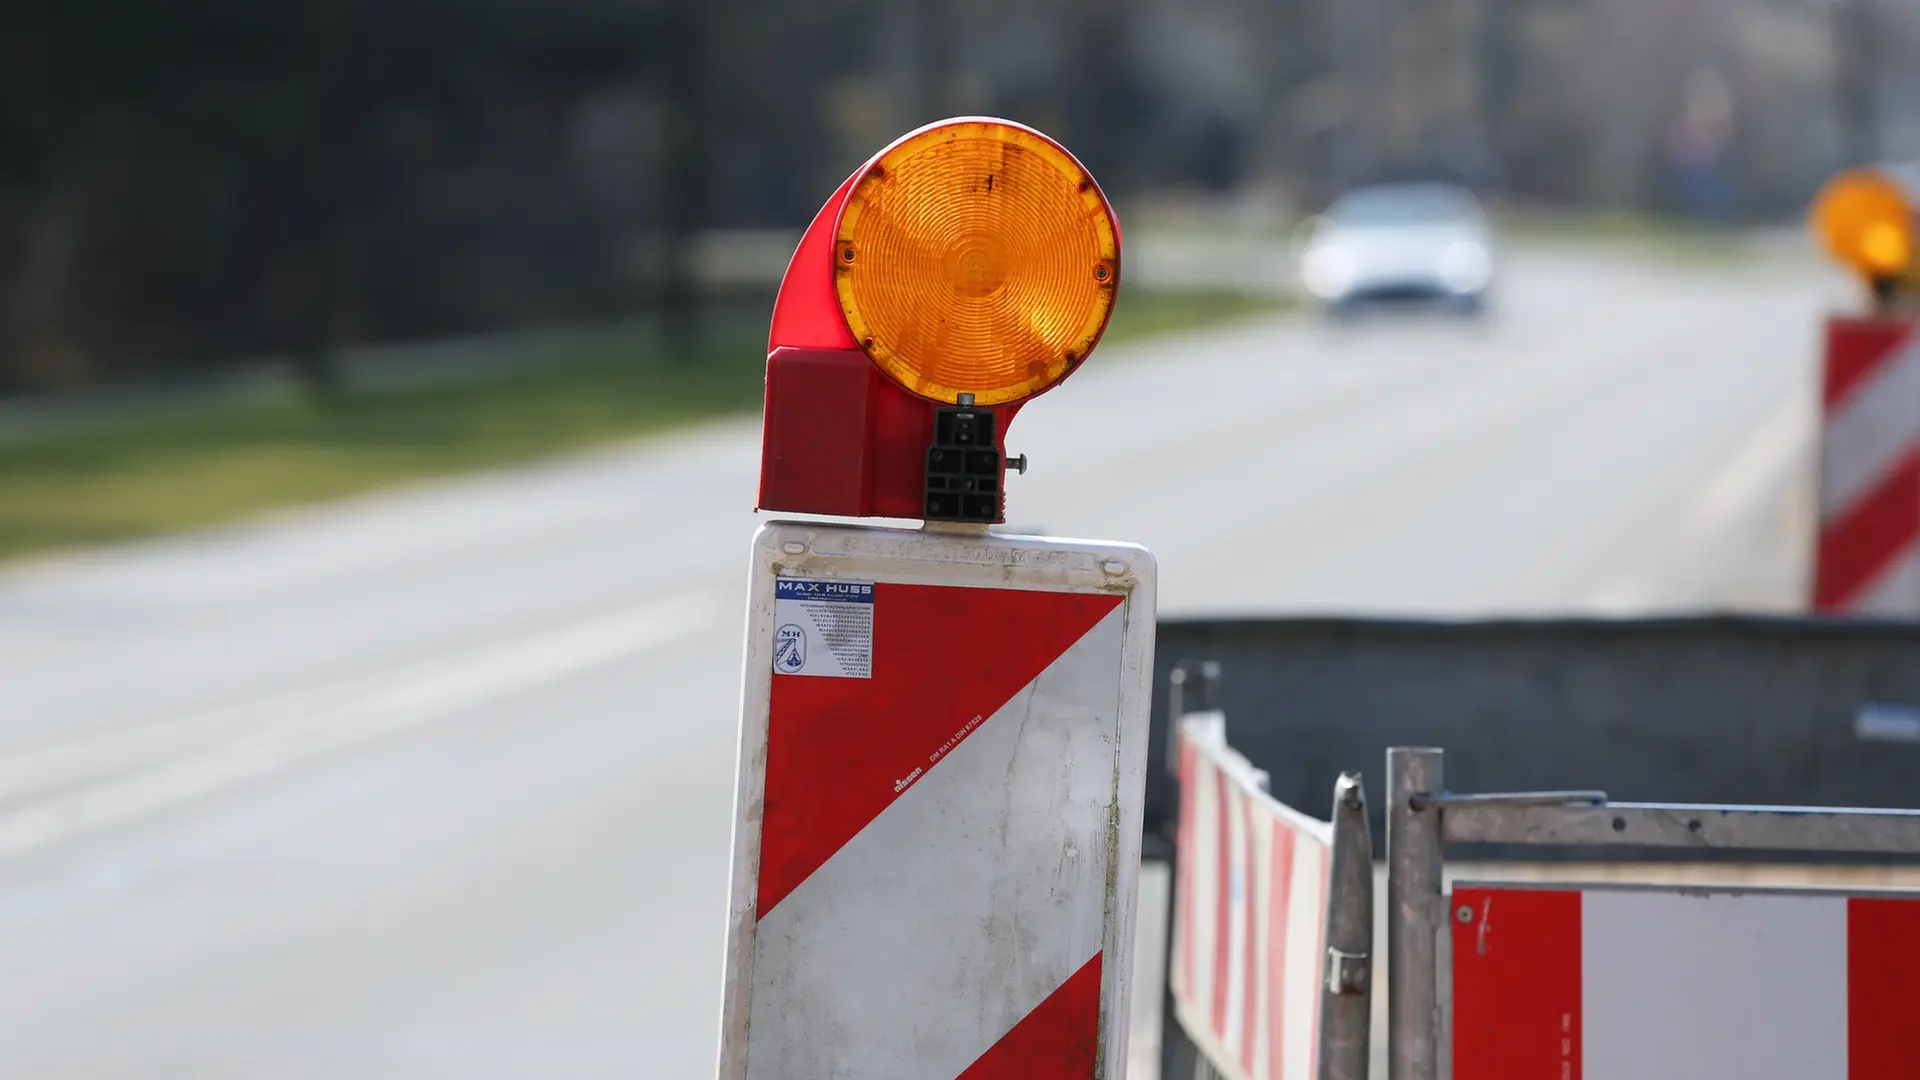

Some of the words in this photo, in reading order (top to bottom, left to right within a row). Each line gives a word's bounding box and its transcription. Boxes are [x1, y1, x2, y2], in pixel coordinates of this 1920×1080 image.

[779, 582, 820, 591] MAX
[826, 584, 872, 594] HUSS
[955, 728, 967, 740] DIN
[894, 766, 922, 793] nissen
